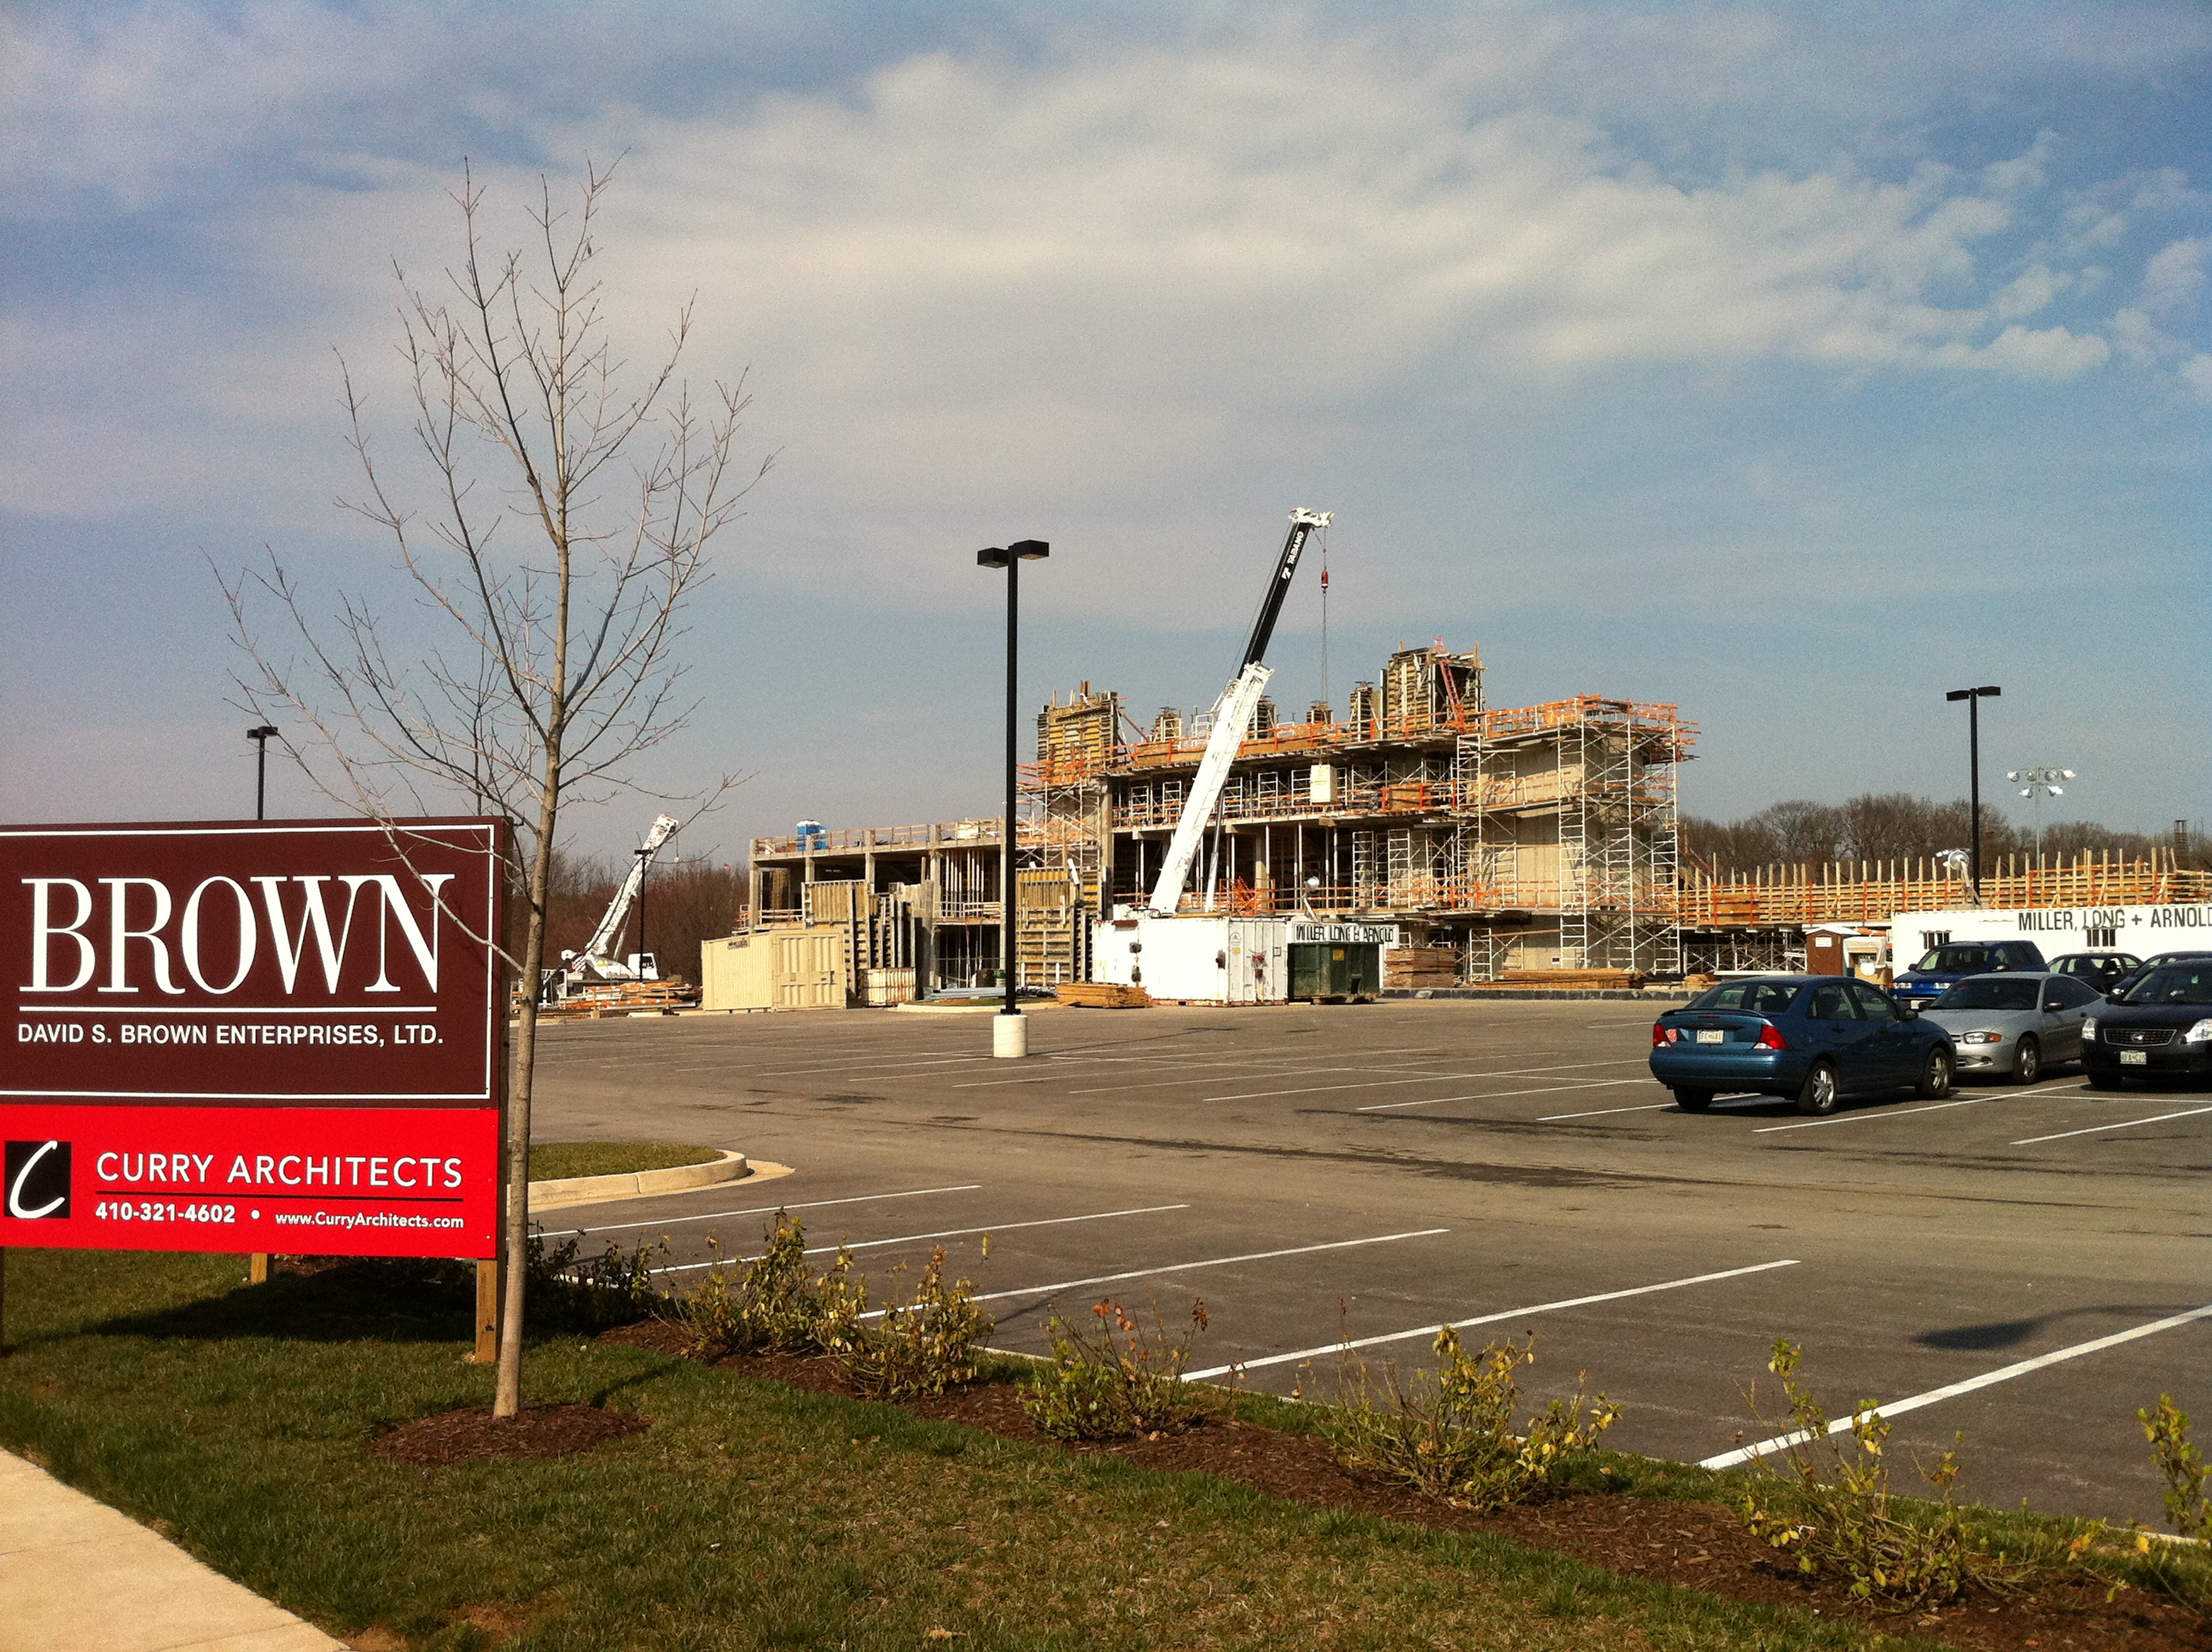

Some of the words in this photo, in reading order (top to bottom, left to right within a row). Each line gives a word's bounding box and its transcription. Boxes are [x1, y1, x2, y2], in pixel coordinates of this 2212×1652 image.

[2018, 911, 2077, 932] MILLER,
[2082, 909, 2125, 929] LONG
[19, 875, 456, 994] BROWN
[1330, 927, 1349, 941] LONG
[1364, 928, 1393, 942] ARNOLD
[18, 1023, 84, 1043] DAVID
[91, 1024, 112, 1044] S.
[121, 1024, 207, 1044] BROWN
[216, 1024, 385, 1048] ENTERPRISES,
[393, 1024, 444, 1044] LTD.
[96, 1152, 214, 1184] CURRY
[227, 1155, 463, 1188] ARCHITECTS
[95, 1201, 236, 1223] 410-321-4602
[275, 1211, 464, 1230] www.CurryArchitects.com
